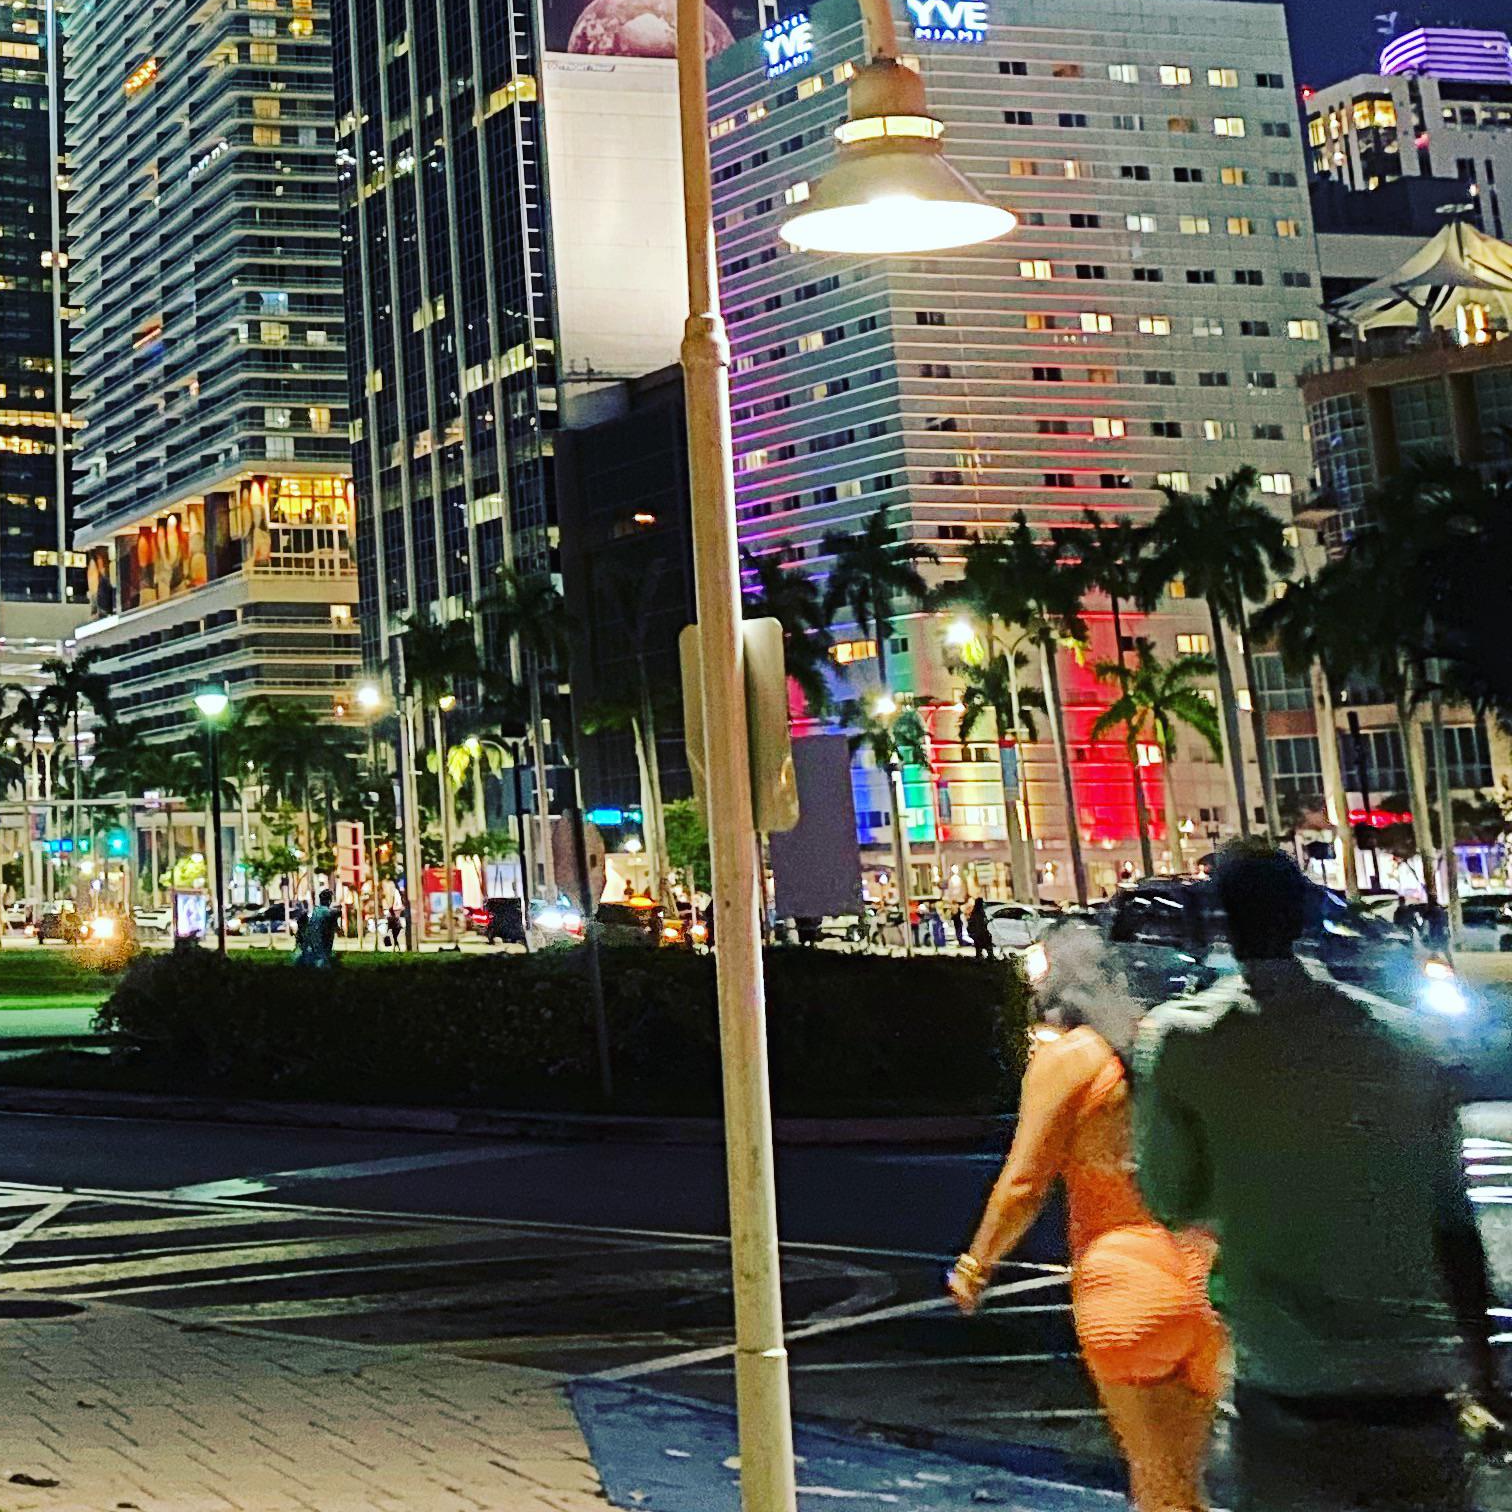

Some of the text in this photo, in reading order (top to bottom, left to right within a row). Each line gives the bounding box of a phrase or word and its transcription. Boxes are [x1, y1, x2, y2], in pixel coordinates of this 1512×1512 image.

[764, 13, 809, 39] HOTEL
[914, 27, 983, 42] MIAMI
[763, 22, 814, 65] YVE
[768, 52, 809, 78] MIAMI
